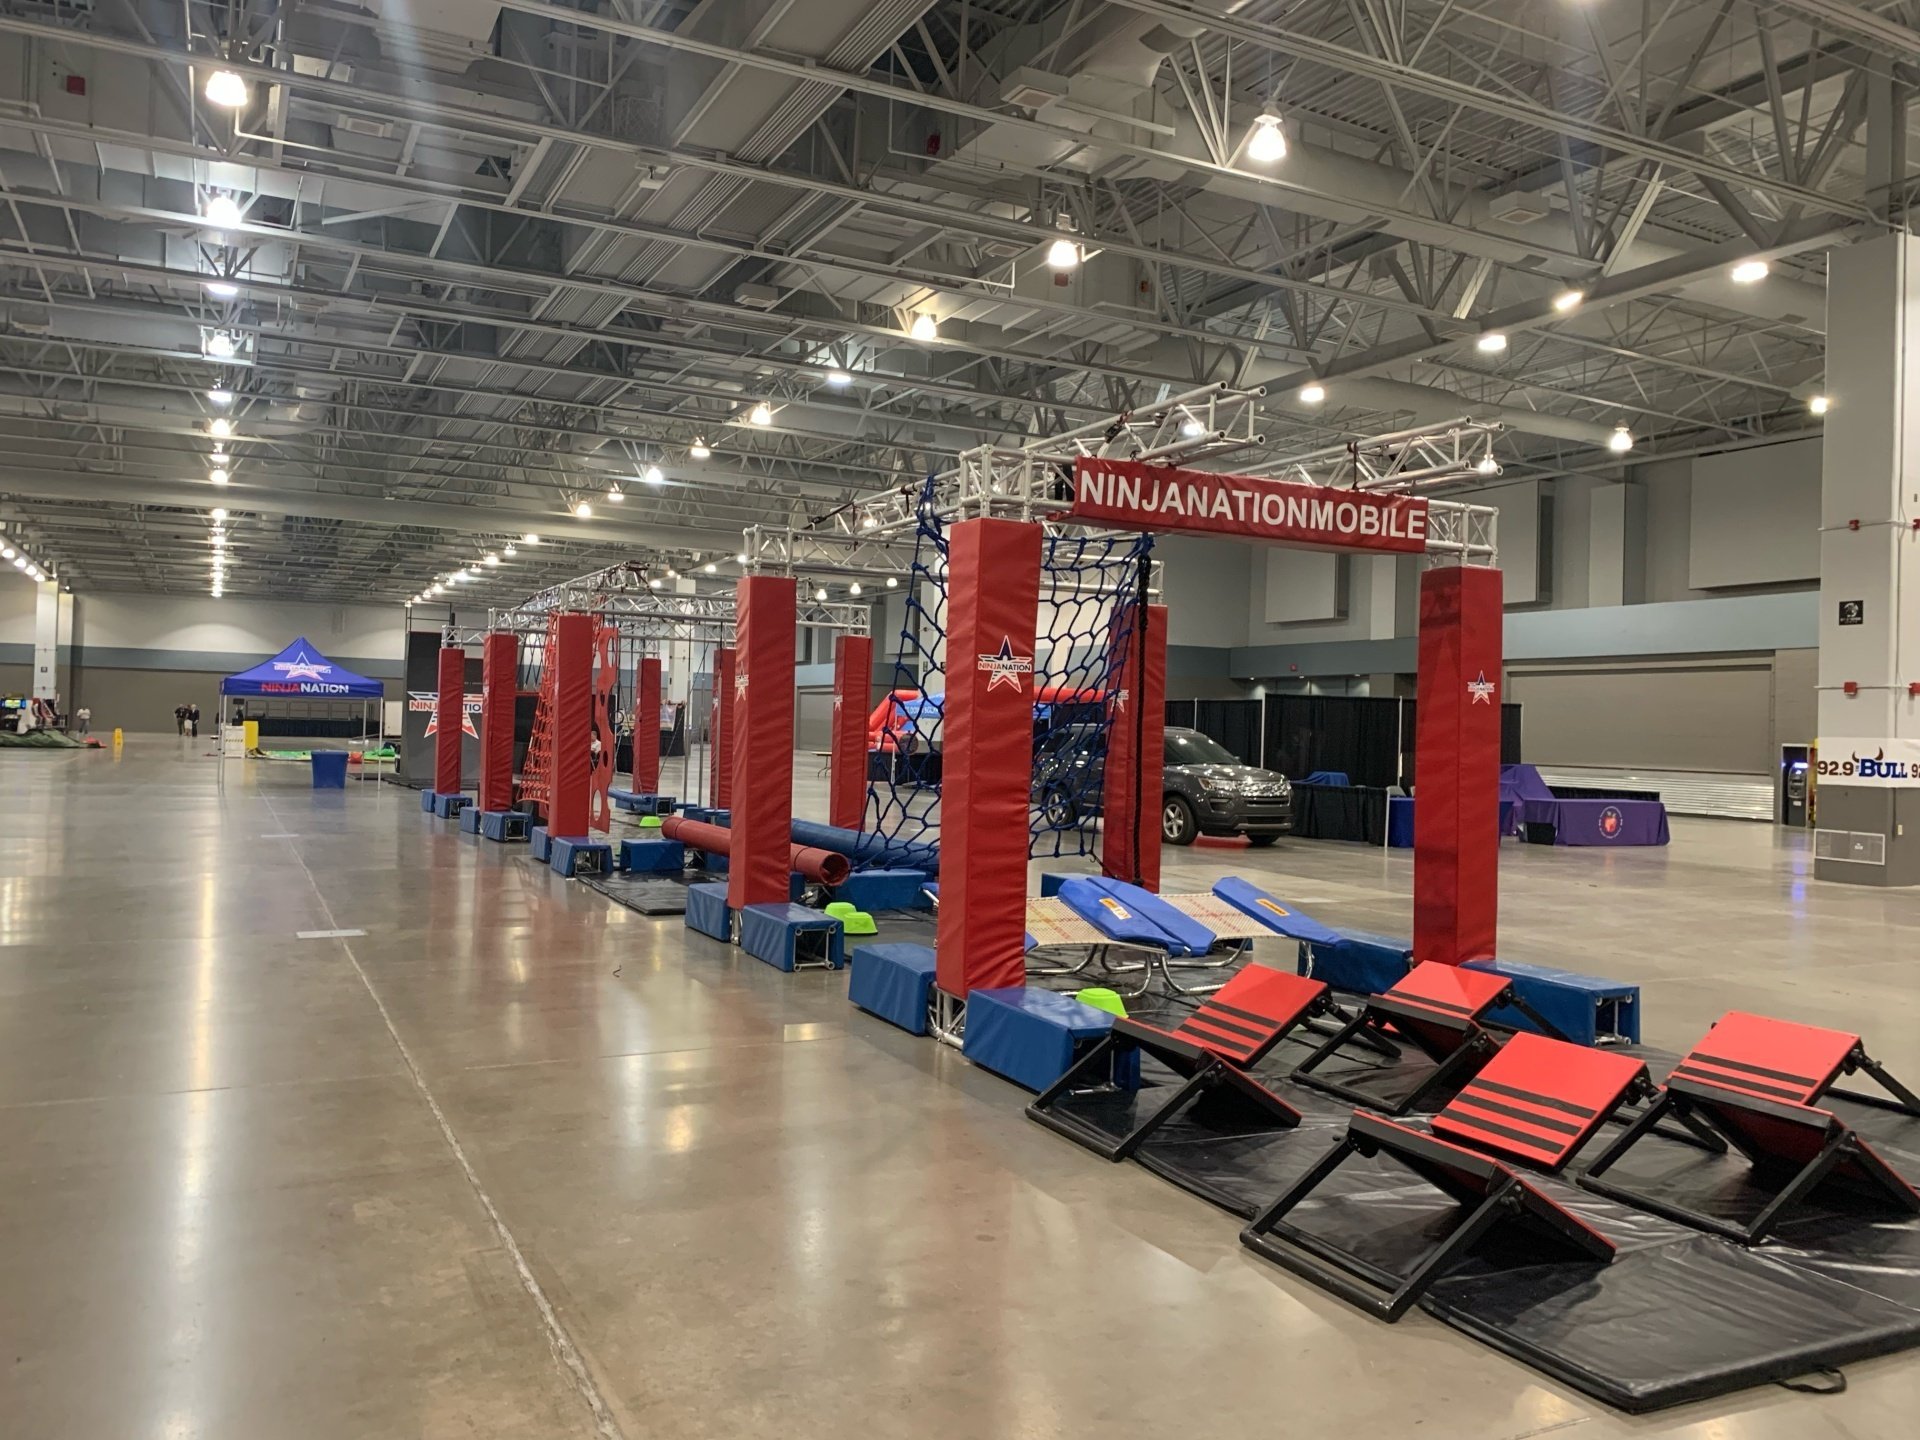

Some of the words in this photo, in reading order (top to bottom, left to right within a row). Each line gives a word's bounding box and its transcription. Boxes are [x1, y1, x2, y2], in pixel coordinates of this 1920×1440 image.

[1079, 470, 1426, 540] NINJANATIONMOBILE
[978, 662, 1031, 672] NINJANATION
[261, 682, 349, 694] NINJANATION
[410, 701, 482, 712] NINJTIO
[1817, 760, 1854, 776] 92.9
[1859, 758, 1908, 778] BULL
[1911, 763, 1920, 778] 9
